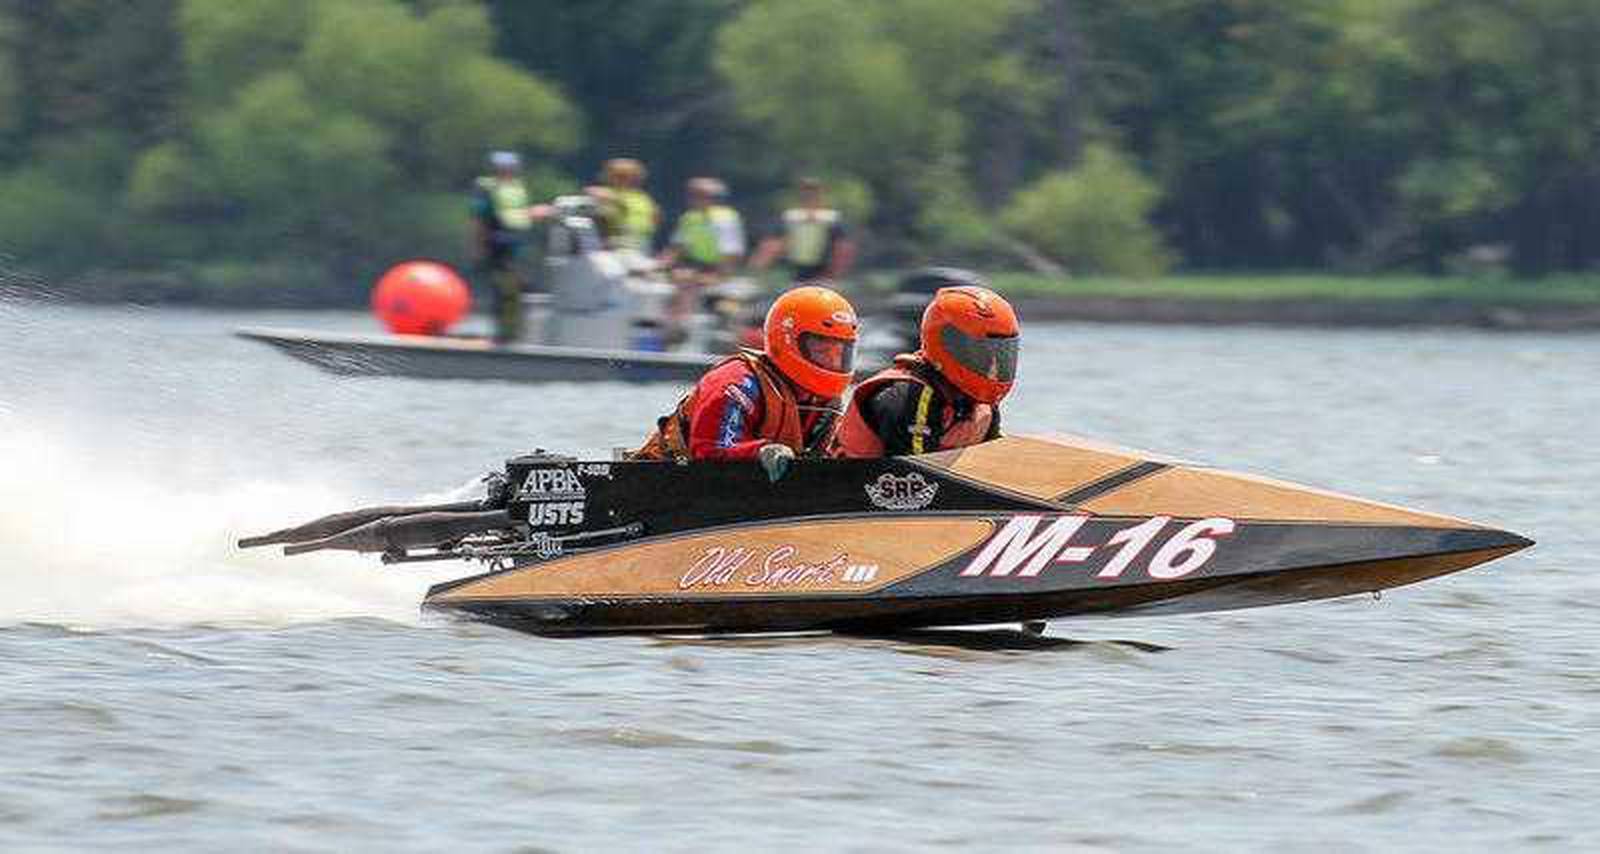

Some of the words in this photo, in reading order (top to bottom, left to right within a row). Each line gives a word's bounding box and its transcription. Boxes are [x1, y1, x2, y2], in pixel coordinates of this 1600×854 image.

[519, 468, 586, 494] APBA
[879, 479, 929, 499] SRP
[528, 501, 585, 526] USTS
[958, 513, 1236, 580] M-16
[679, 546, 756, 589] Old
